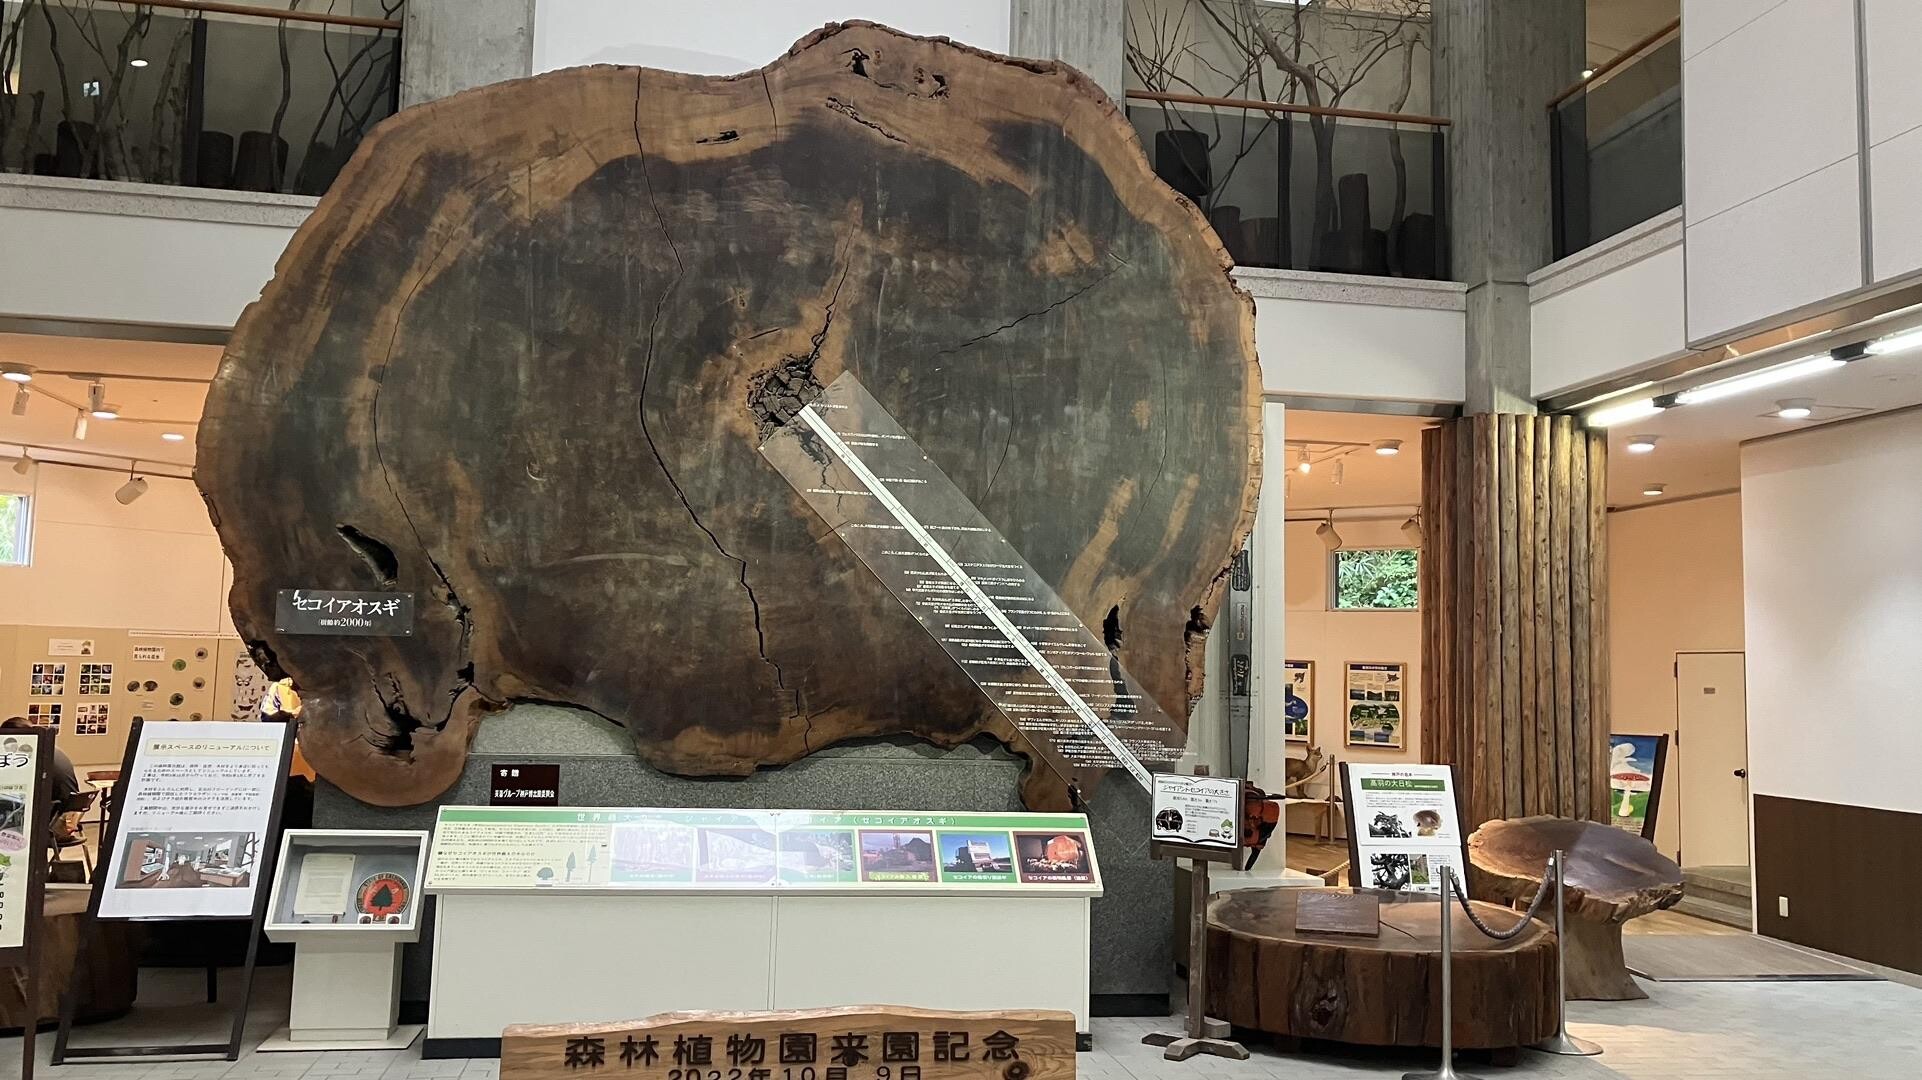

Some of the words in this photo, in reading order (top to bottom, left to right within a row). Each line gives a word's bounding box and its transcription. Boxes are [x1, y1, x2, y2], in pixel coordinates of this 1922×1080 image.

[292, 590, 400, 616] セコイアオスギ
[564, 1030, 1020, 1068] 森林植物園来園記念
